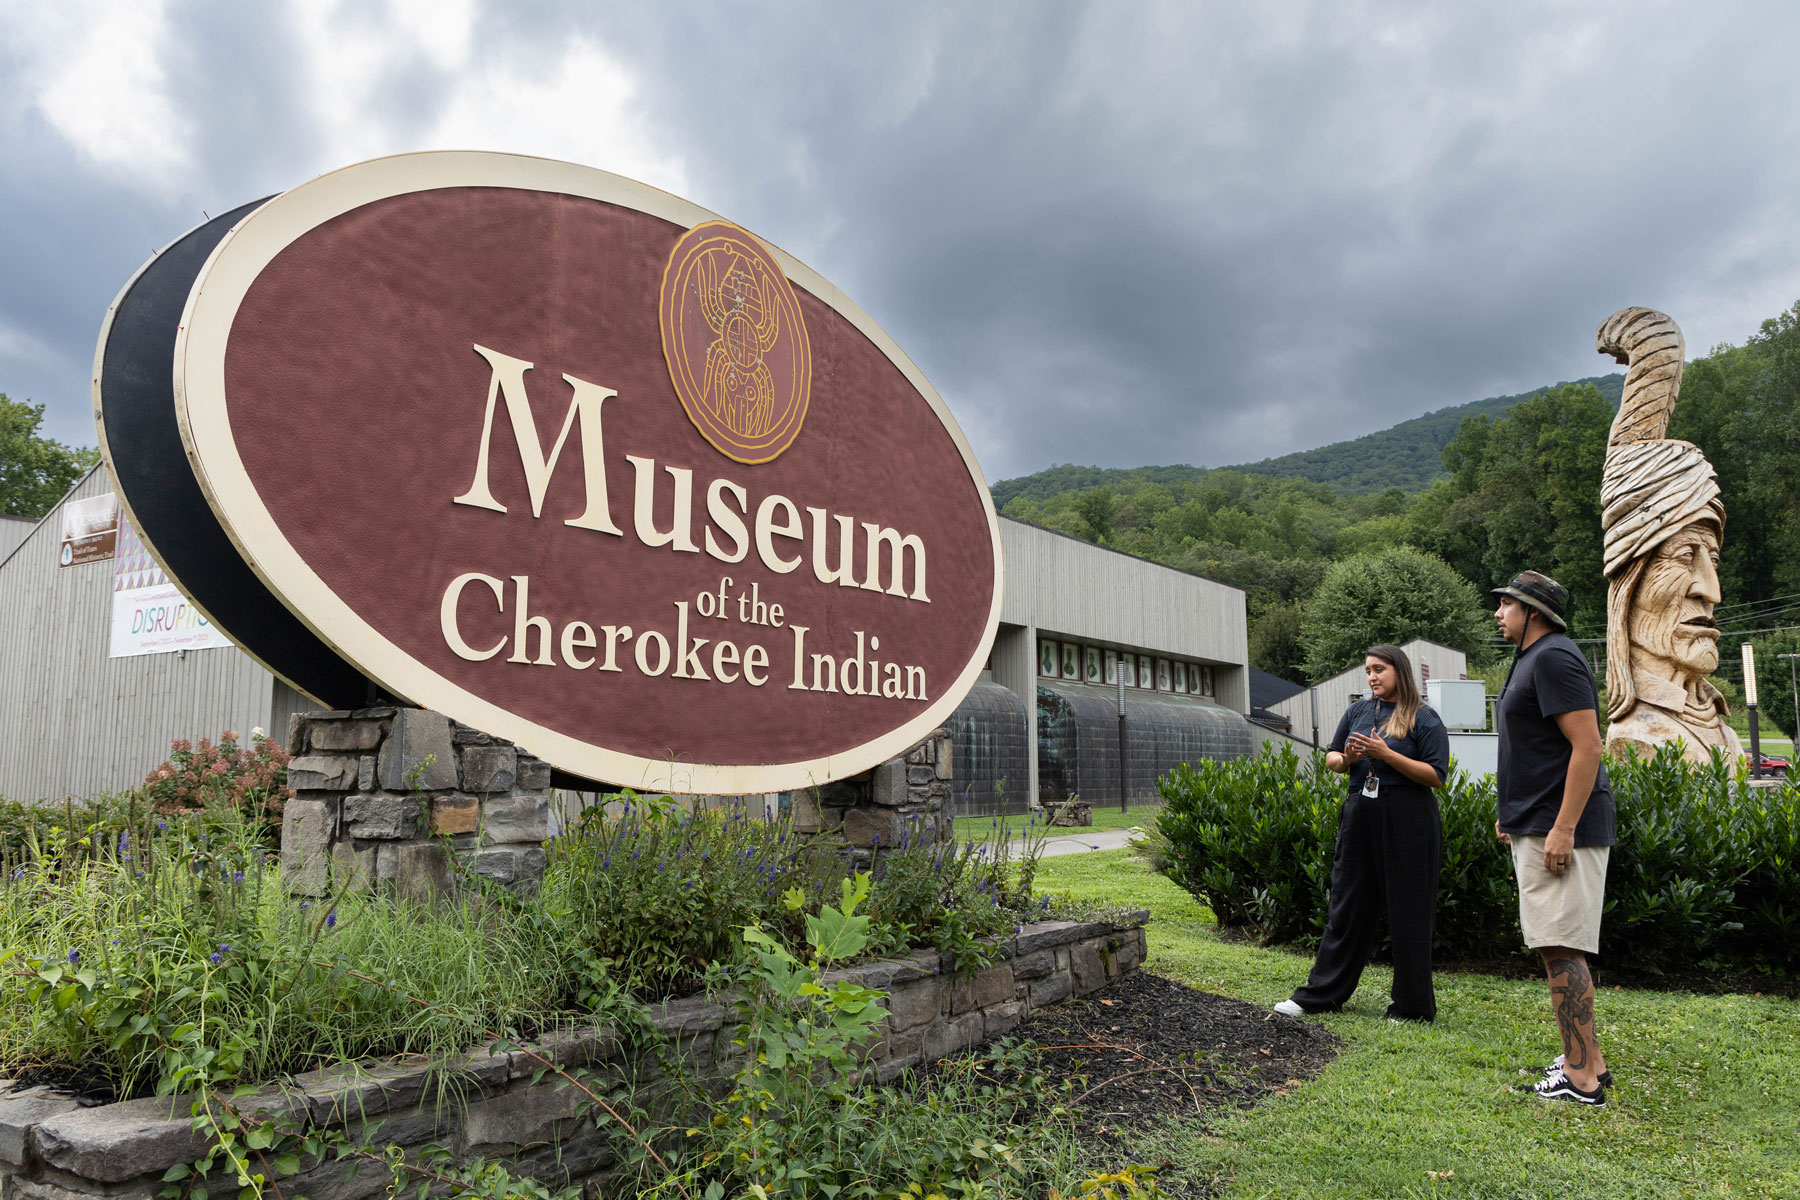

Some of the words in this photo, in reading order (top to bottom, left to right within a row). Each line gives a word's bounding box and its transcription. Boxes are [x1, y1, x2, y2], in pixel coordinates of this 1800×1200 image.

[453, 343, 931, 604] Museum
[440, 572, 770, 686] Cherokee
[787, 624, 929, 701] Indian
[696, 576, 734, 620] of
[737, 582, 785, 628] the
